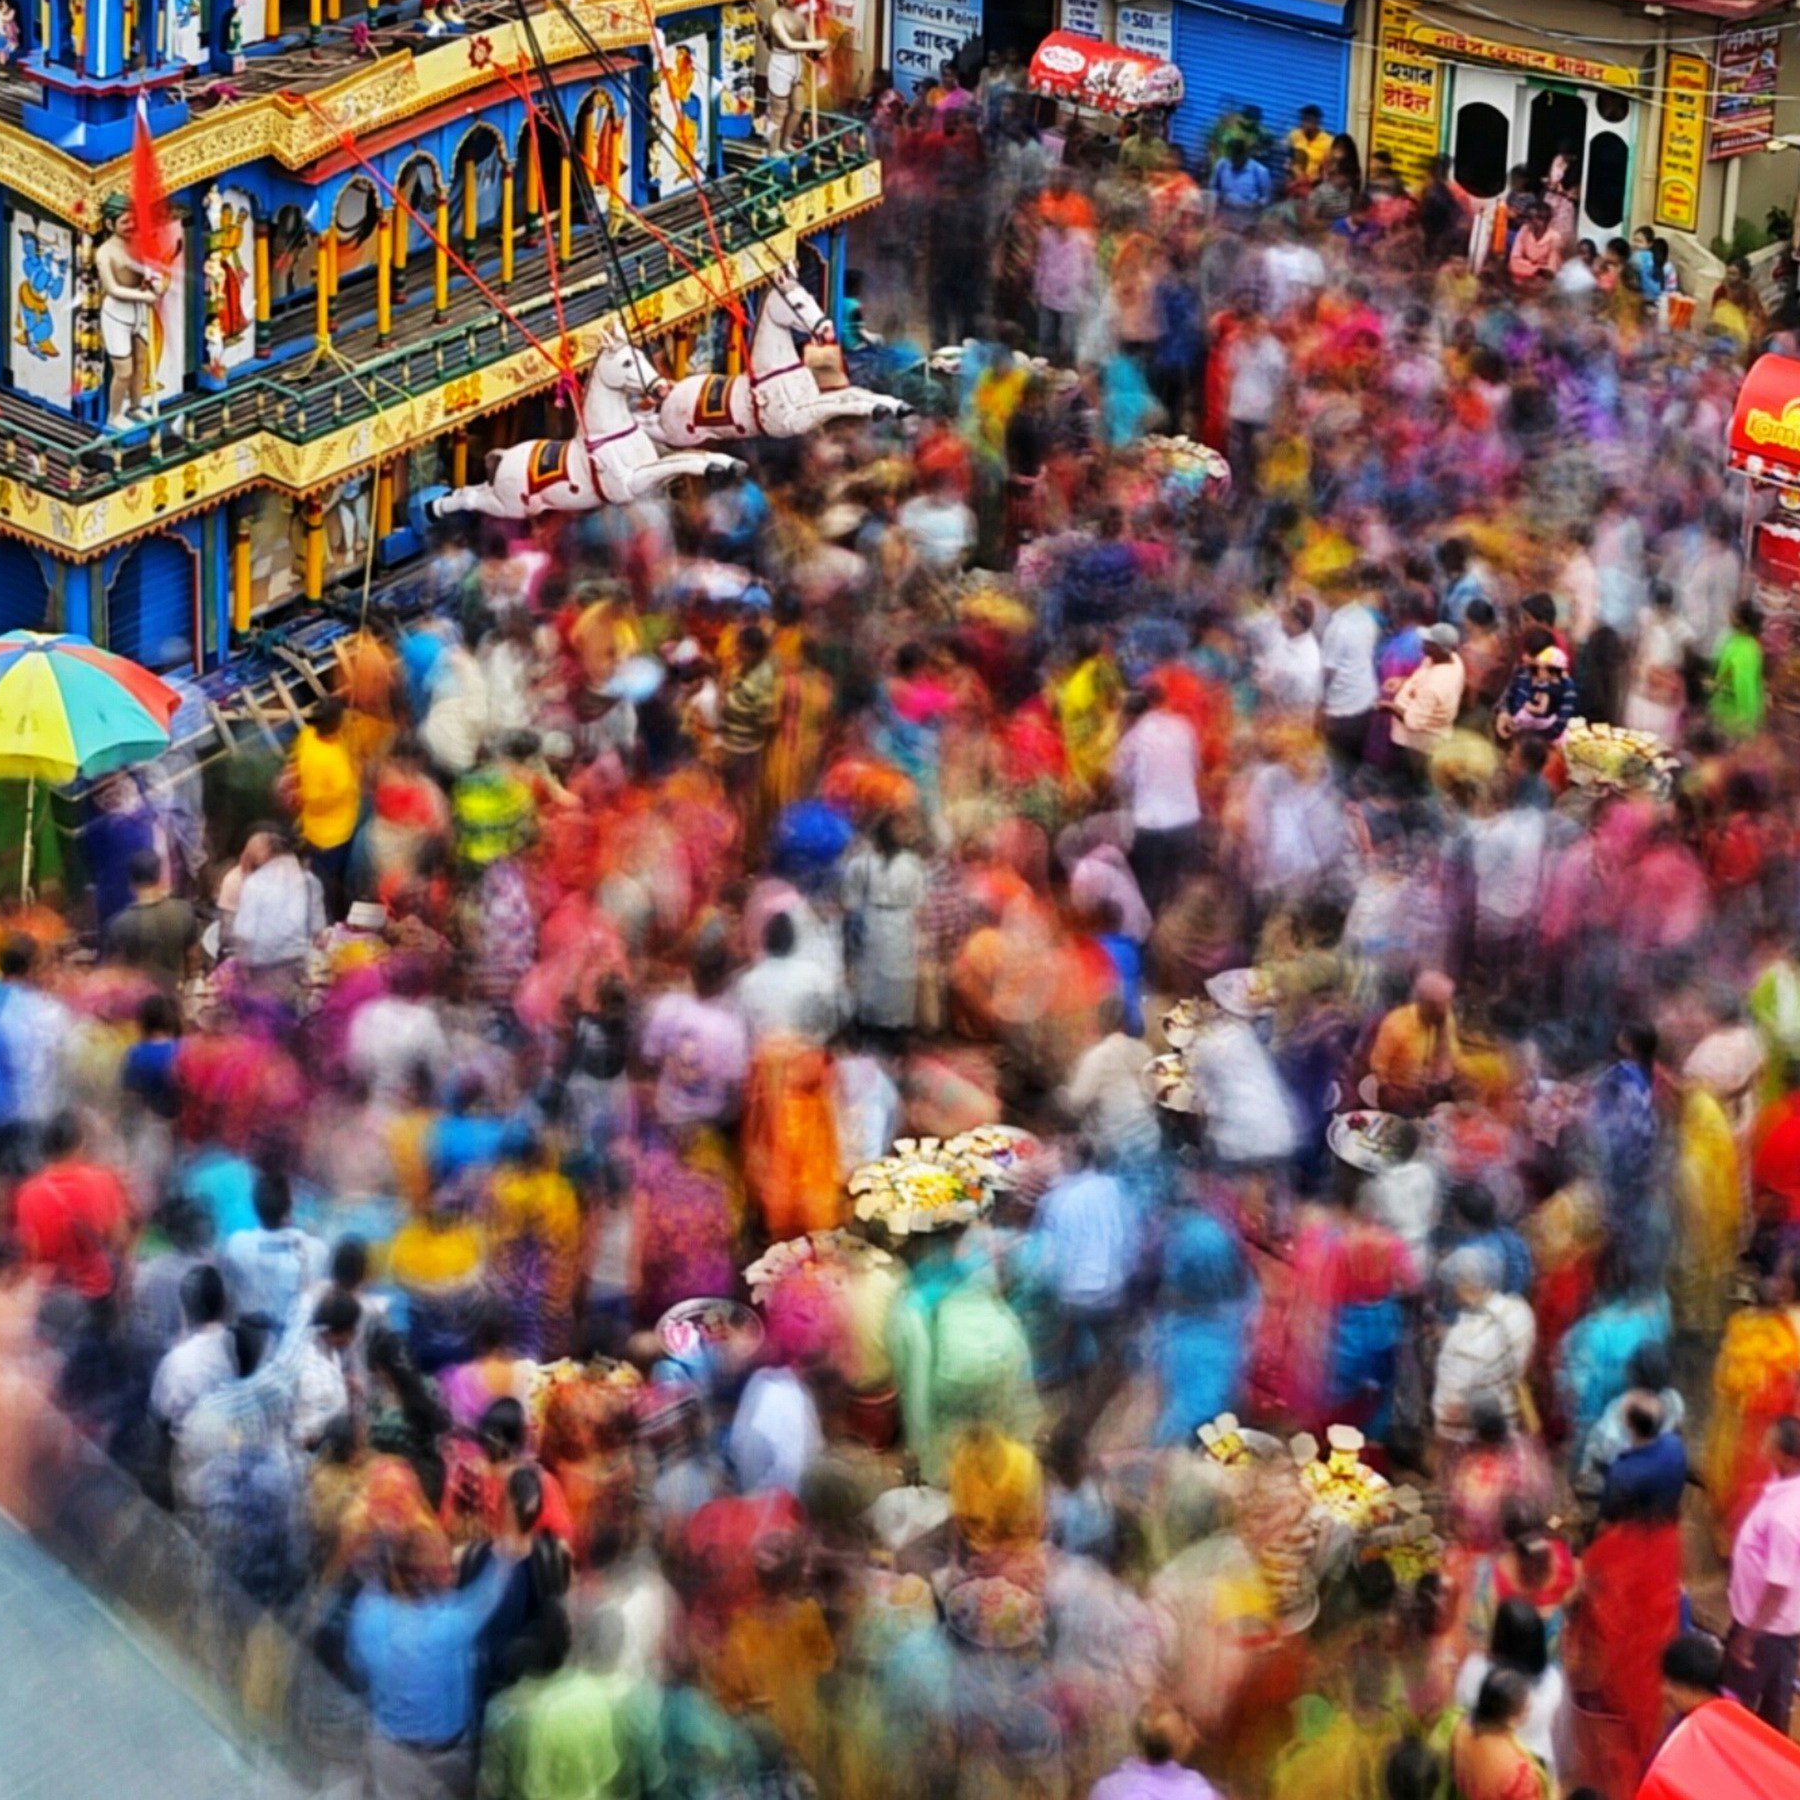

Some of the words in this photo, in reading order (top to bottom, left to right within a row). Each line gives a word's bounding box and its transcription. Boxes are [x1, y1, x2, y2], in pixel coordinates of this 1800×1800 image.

[946, 7, 980, 28] Point
[1131, 13, 1154, 30] SBI
[913, 29, 960, 54] গ্রাহক
[896, 49, 933, 71] সেবা
[1383, 61, 1433, 87] হেয়ার
